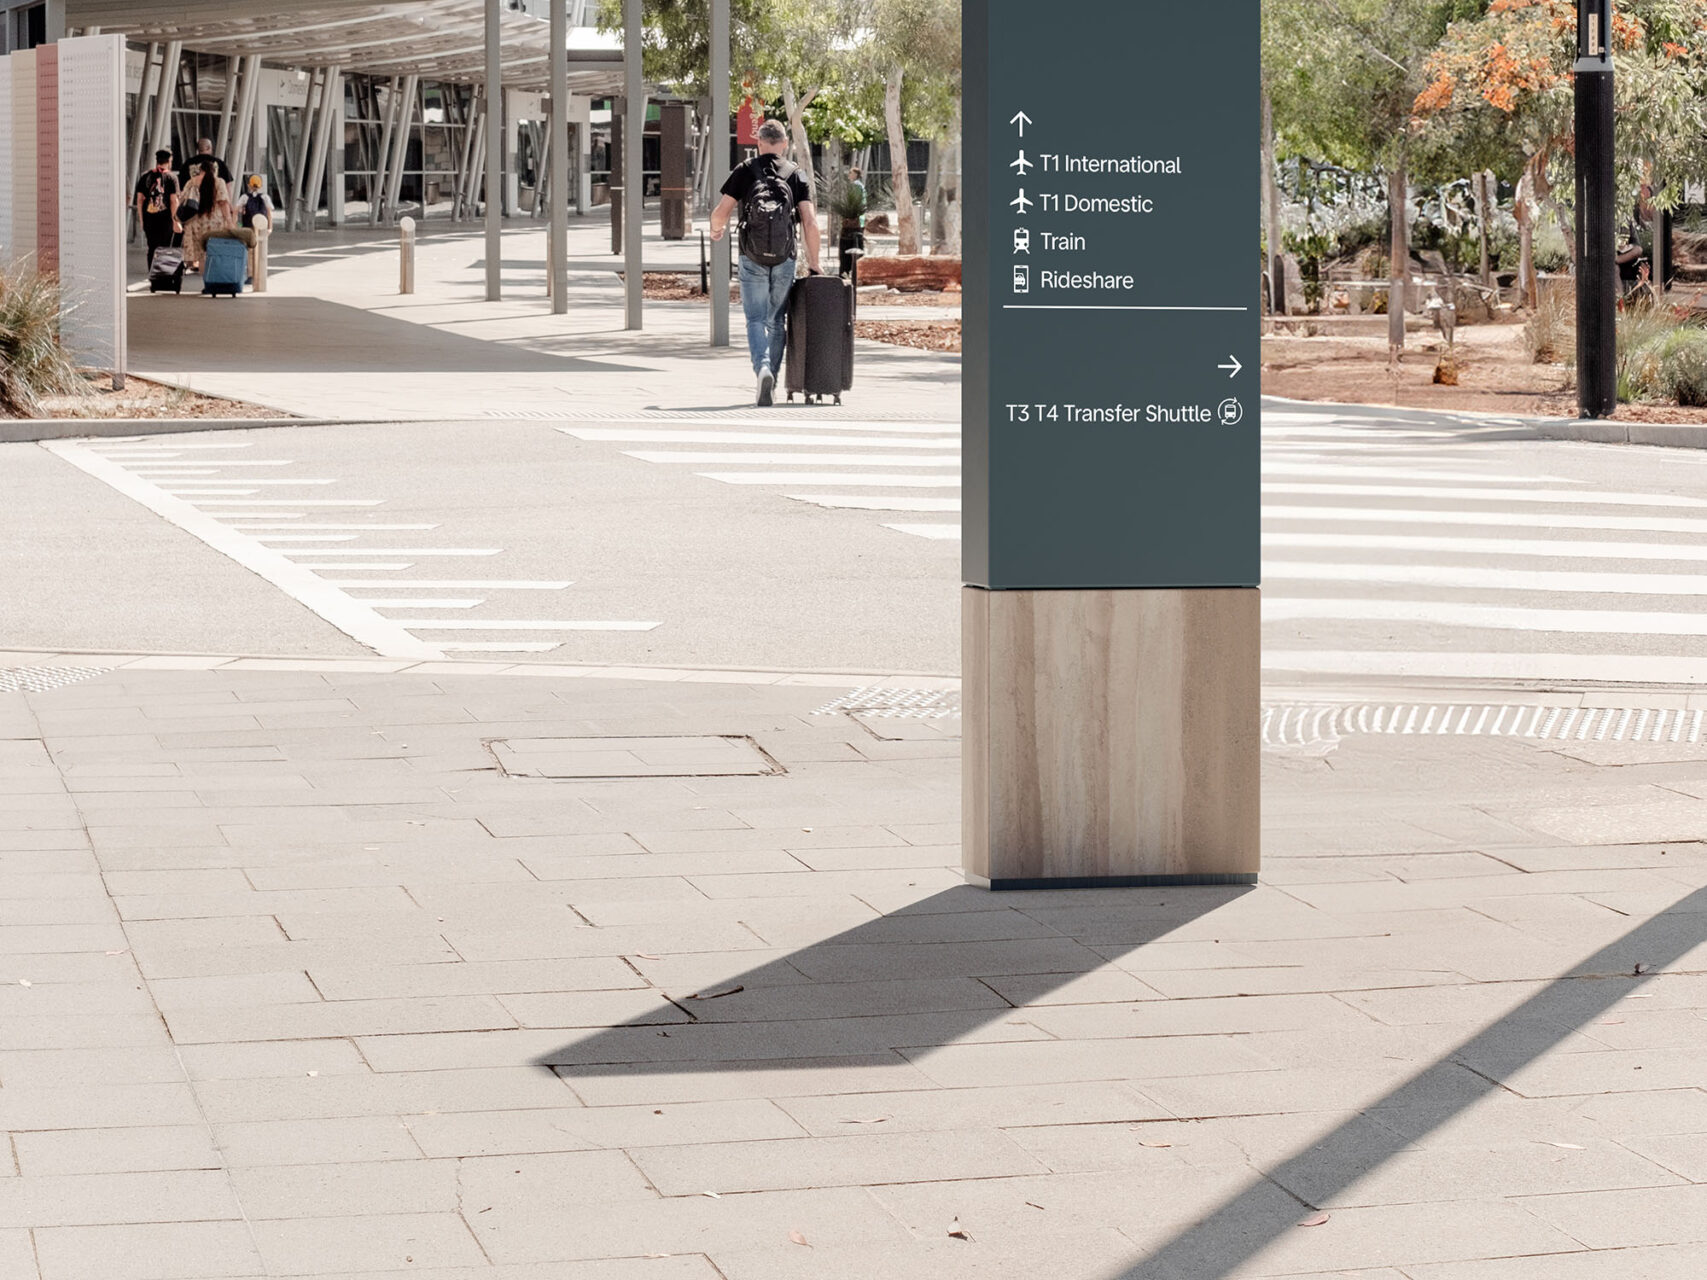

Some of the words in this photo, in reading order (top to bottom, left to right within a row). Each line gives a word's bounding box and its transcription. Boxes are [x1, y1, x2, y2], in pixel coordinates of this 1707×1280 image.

[1040, 154, 1058, 171] T1
[1066, 155, 1181, 173] International
[1039, 194, 1058, 211] T1
[1065, 194, 1153, 212] Domestic
[1040, 233, 1085, 250] Train
[1042, 271, 1134, 289] Rideshare
[1006, 404, 1029, 421] T3
[1035, 405, 1058, 421] T4
[1064, 404, 1140, 422] Transfer
[1146, 405, 1211, 422] Shuttle
